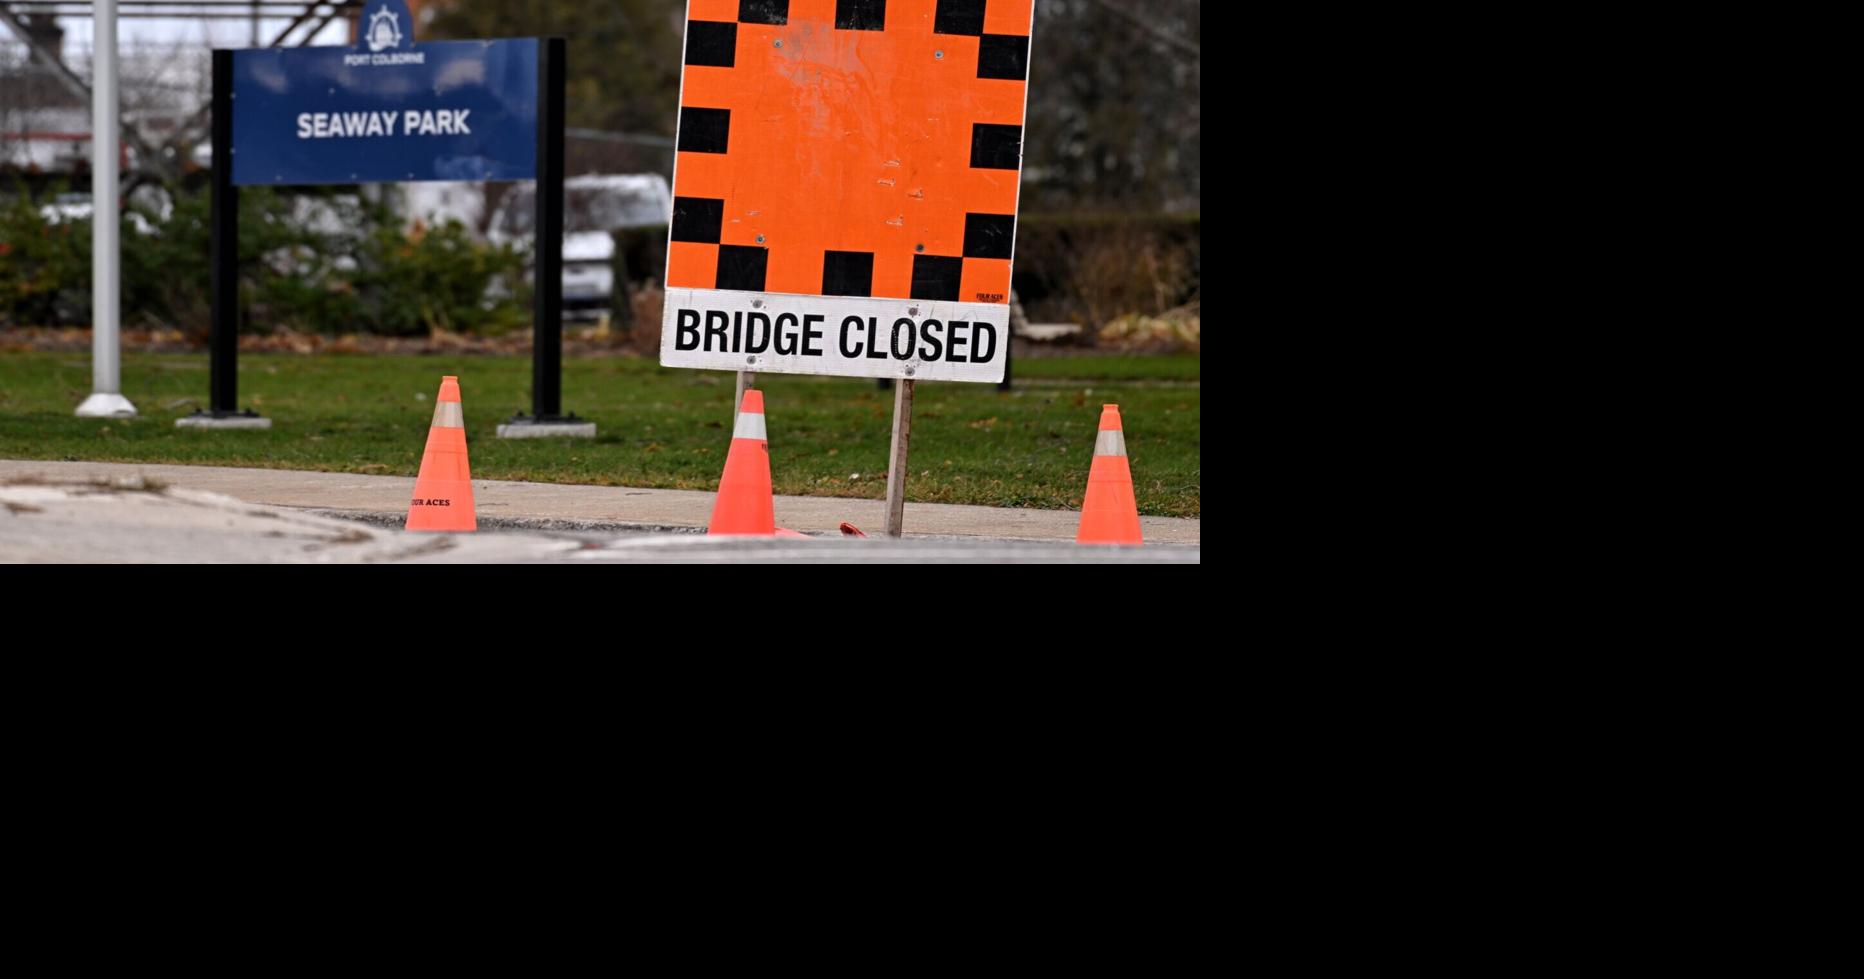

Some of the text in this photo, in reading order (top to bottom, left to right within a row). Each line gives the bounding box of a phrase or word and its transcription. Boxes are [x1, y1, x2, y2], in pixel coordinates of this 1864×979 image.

[345, 53, 425, 66] PORT COLBORNE
[297, 109, 471, 138] SEAWAY PARK
[675, 309, 997, 364] BRIDGE CLOSED
